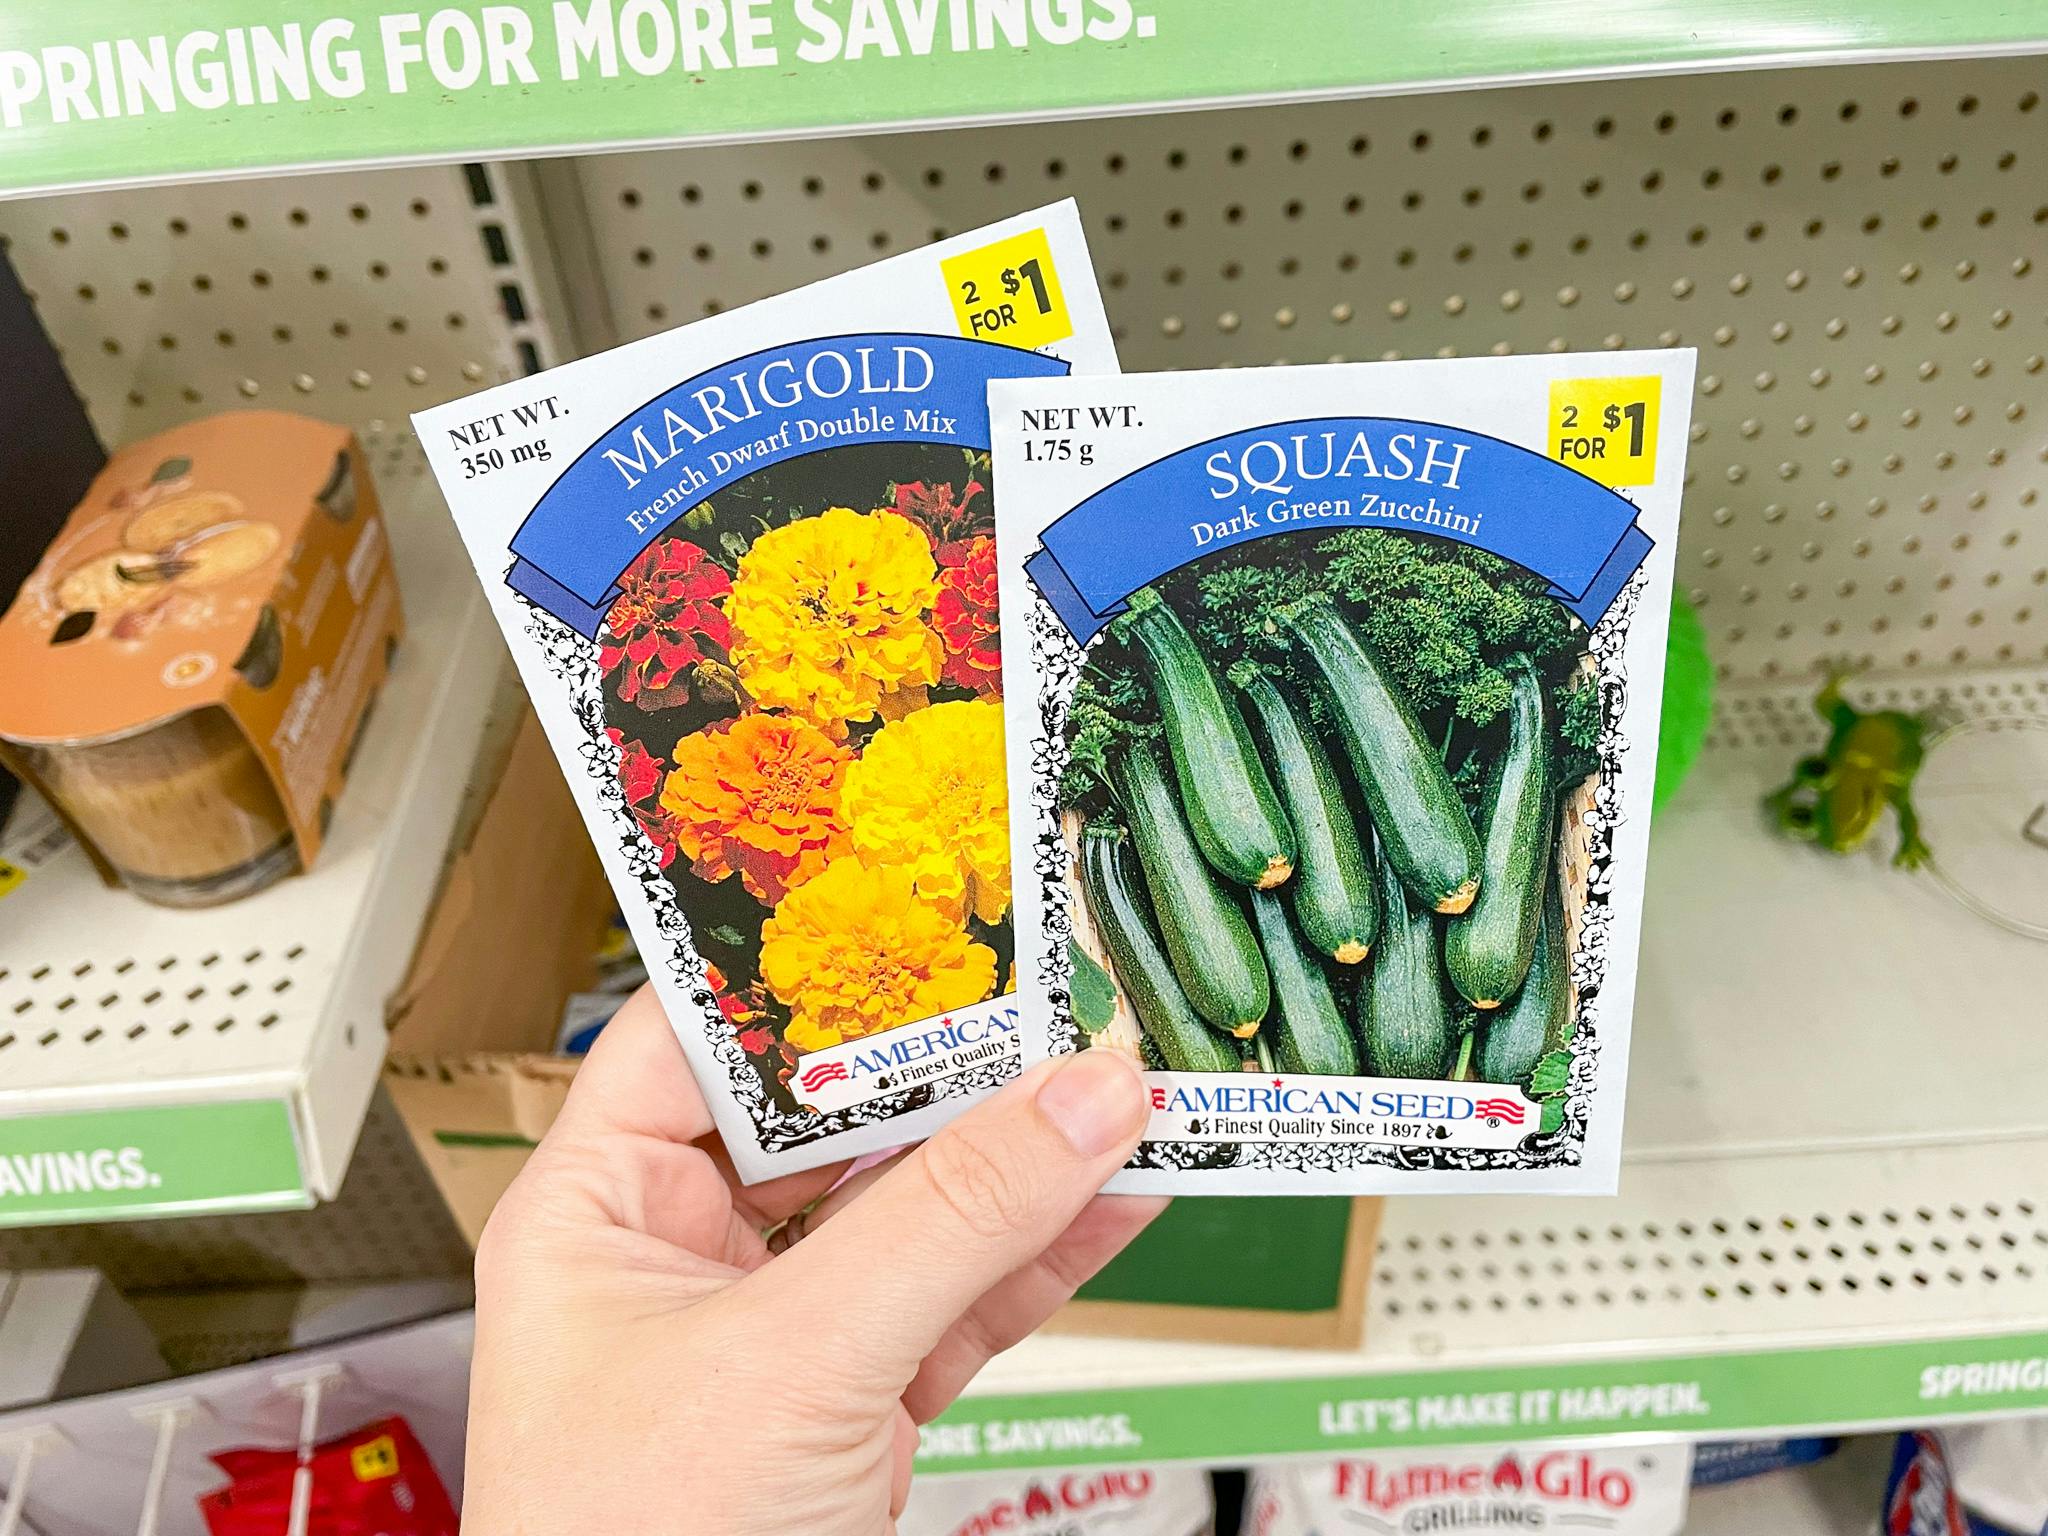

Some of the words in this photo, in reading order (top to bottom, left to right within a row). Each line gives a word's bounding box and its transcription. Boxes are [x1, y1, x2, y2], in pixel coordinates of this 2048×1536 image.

[379, 8, 539, 94] FOR
[554, 0, 778, 81] MORE
[796, 0, 1157, 64] SAVINGS.
[961, 281, 980, 304] 2
[1001, 258, 1051, 314] $1
[969, 303, 1017, 336] FOR
[447, 413, 506, 451] NET
[511, 396, 570, 428] WT.
[602, 346, 934, 490] MARIGOLD
[1021, 408, 1080, 431] NET
[1088, 405, 1143, 429] WT.
[1562, 405, 1578, 428] 2
[1603, 402, 1645, 457] $1
[460, 448, 504, 479] 350
[510, 439, 552, 462] mg
[625, 468, 710, 535] French
[708, 421, 794, 477] Dwarf
[796, 406, 895, 445] Double
[904, 409, 957, 434] Mix
[1023, 439, 1072, 462] 1.75
[1079, 444, 1094, 466] g
[1205, 431, 1471, 500] SQUASH
[1560, 437, 1606, 460] FOR
[1190, 504, 1261, 547] Dark
[1267, 499, 1351, 524] Green
[1360, 493, 1483, 536] Zucchini
[902, 1060, 949, 1083] Finest
[952, 1039, 1006, 1069] Quality
[1166, 1086, 1364, 1115] AMERICAN
[1371, 1092, 1474, 1120] SEED
[1214, 1119, 1263, 1135] Finest
[1269, 1119, 1324, 1138] Quality
[1330, 1120, 1375, 1136] Since
[1382, 1123, 1421, 1139] 1897
[1319, 1397, 1412, 1435] LET'S
[1416, 1391, 1516, 1430] MAKE
[1520, 1388, 1556, 1424] IT
[1559, 1381, 1710, 1422] HAPPEN.
[983, 1413, 1142, 1456] SAVINGS.
